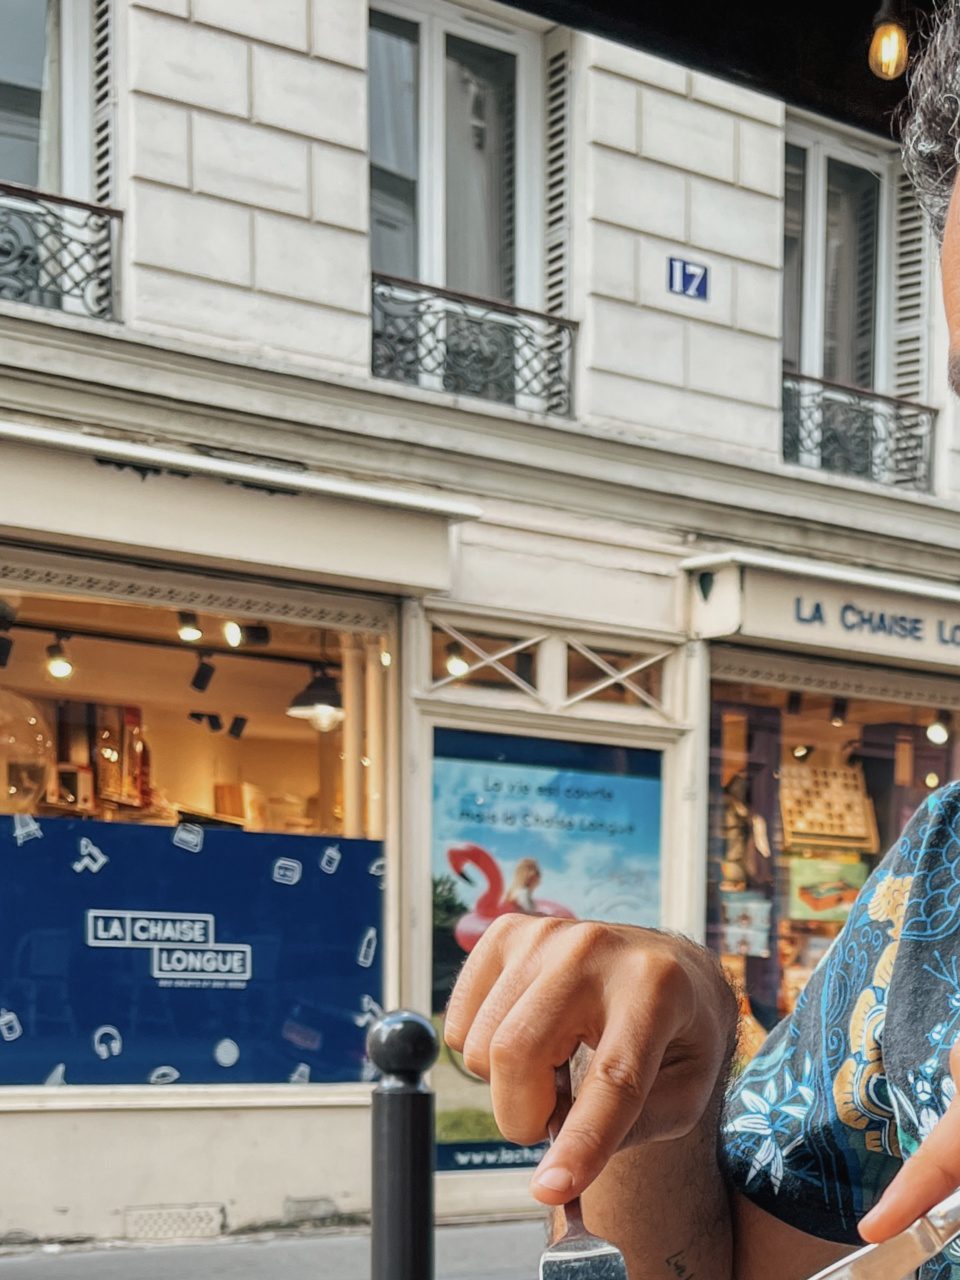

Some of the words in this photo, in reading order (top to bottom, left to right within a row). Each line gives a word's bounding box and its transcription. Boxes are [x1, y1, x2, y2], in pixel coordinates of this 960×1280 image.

[672, 261, 705, 297] 17
[795, 597, 824, 625] LA
[841, 603, 923, 641] CHAISE
[97, 917, 124, 939] LA
[133, 918, 207, 942] CHAISE
[161, 949, 246, 973] LONGUE
